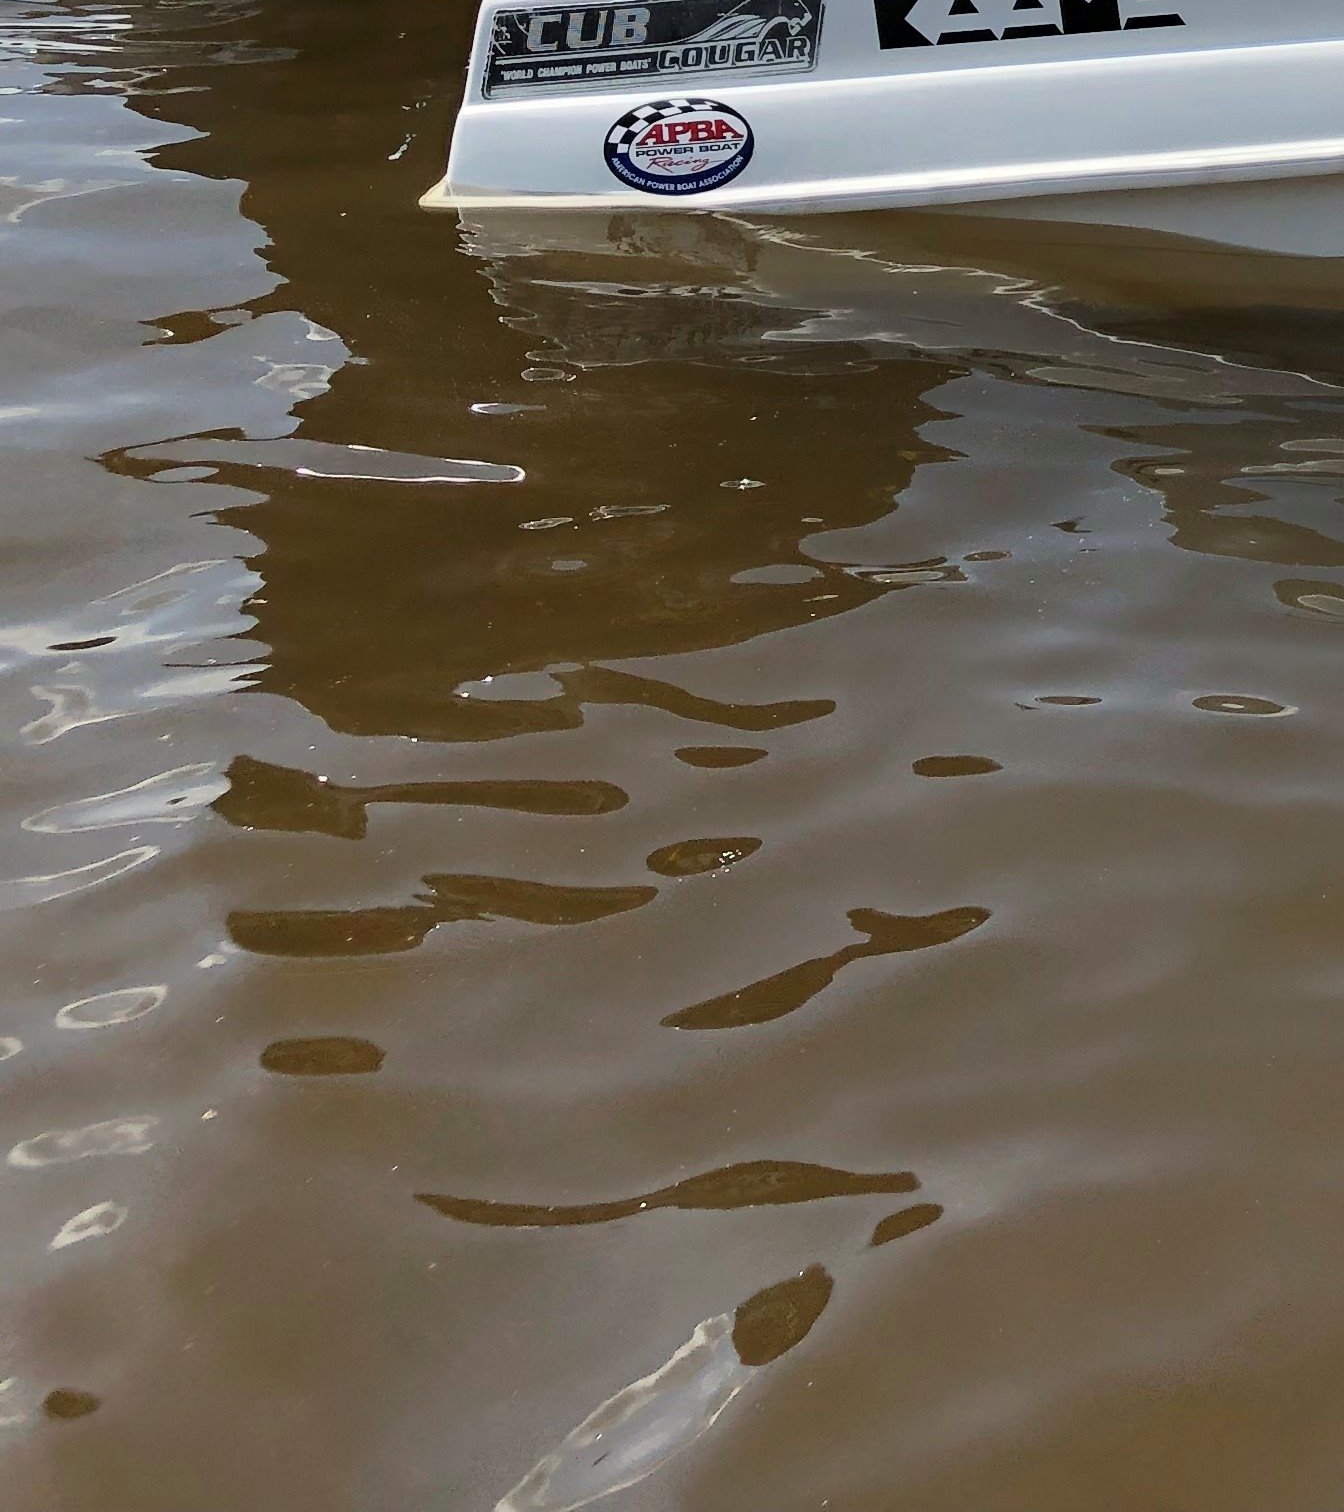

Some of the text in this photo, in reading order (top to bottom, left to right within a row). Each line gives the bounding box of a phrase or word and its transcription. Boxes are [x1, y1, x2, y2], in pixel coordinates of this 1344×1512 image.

[526, 7, 651, 53] CUB
[657, 36, 812, 71] COUGAR
[537, 63, 582, 79] CHAMPION
[585, 61, 617, 75] POWER
[635, 119, 744, 147] APBA
[635, 143, 740, 158] POWER BOAT
[646, 156, 727, 173] Racing
[611, 154, 744, 191] AMERICAN POWER BOAT ASSOCIATION
